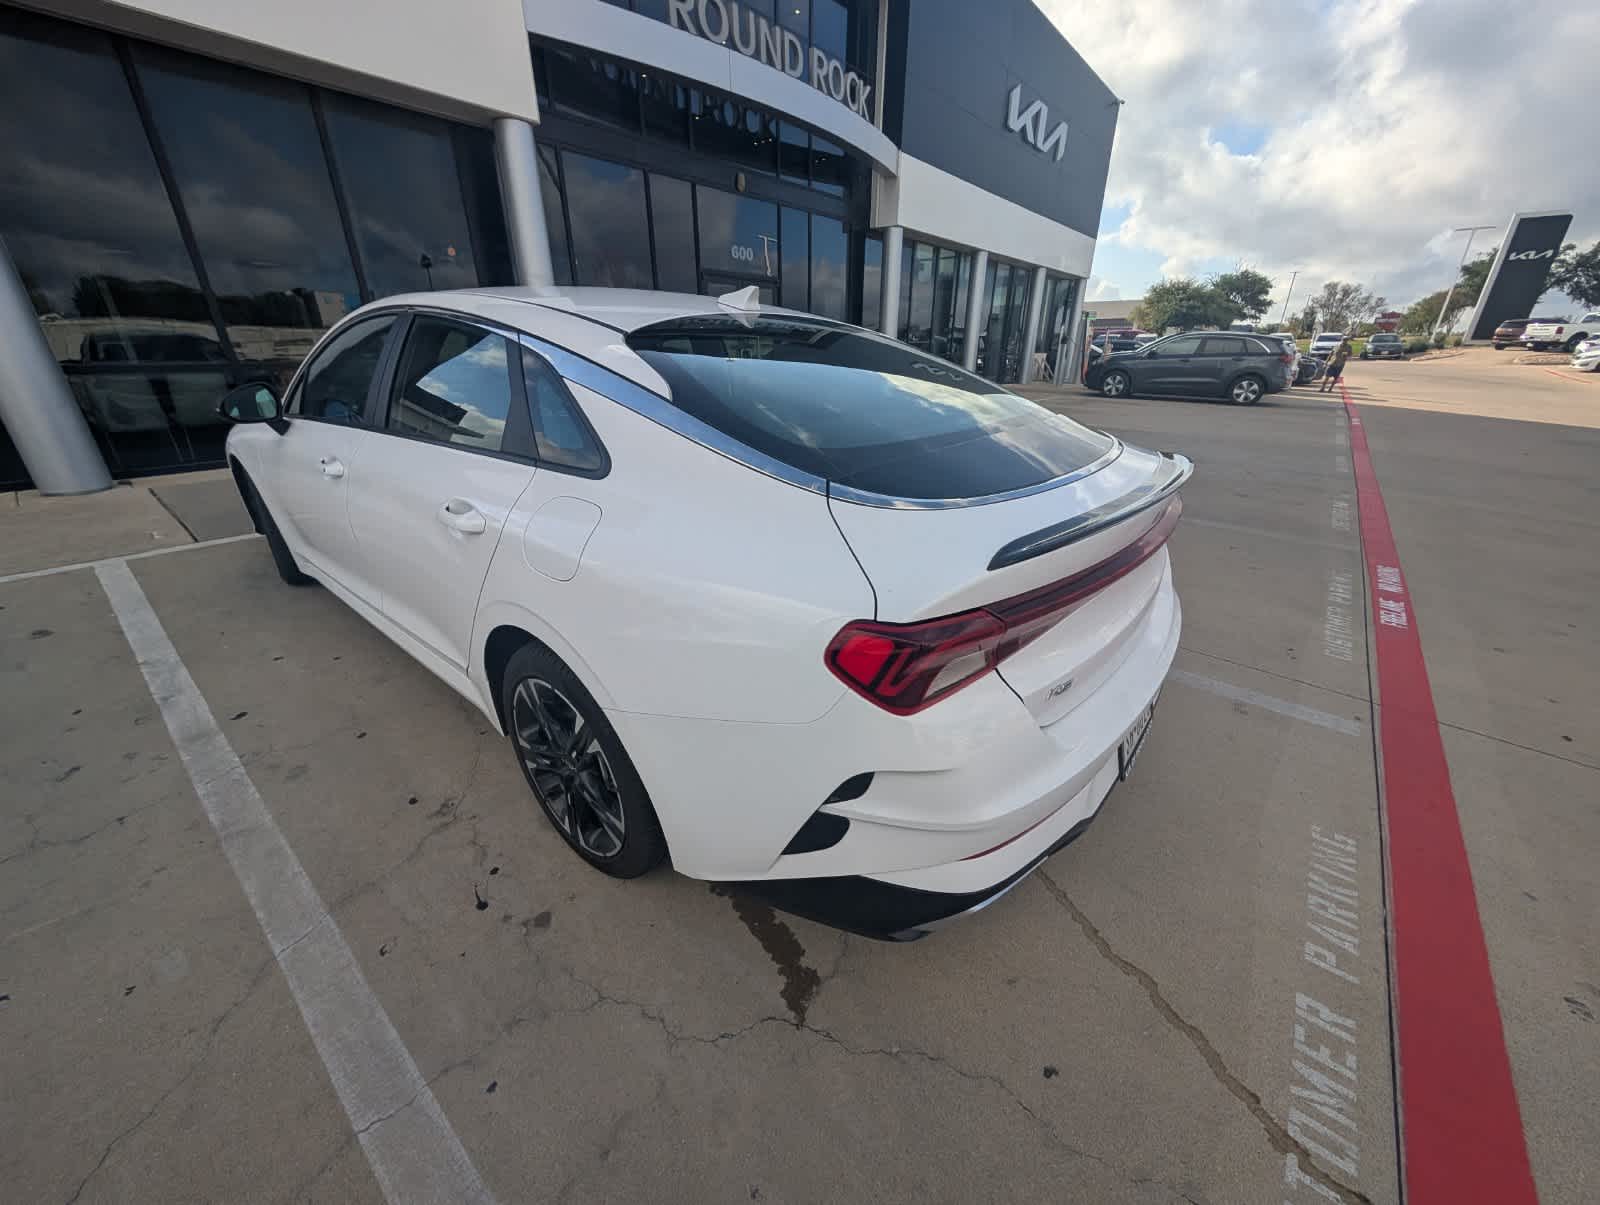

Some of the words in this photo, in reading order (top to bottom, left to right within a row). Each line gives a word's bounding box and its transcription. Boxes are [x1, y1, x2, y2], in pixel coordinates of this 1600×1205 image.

[669, 0, 803, 78] ROUND
[809, 47, 871, 121] ROCK
[1008, 83, 1068, 161] KIA
[731, 245, 754, 261] 600
[1509, 249, 1553, 260] KIA
[1304, 825, 1360, 984] PARKING
[1283, 992, 1359, 1205] TOMER
